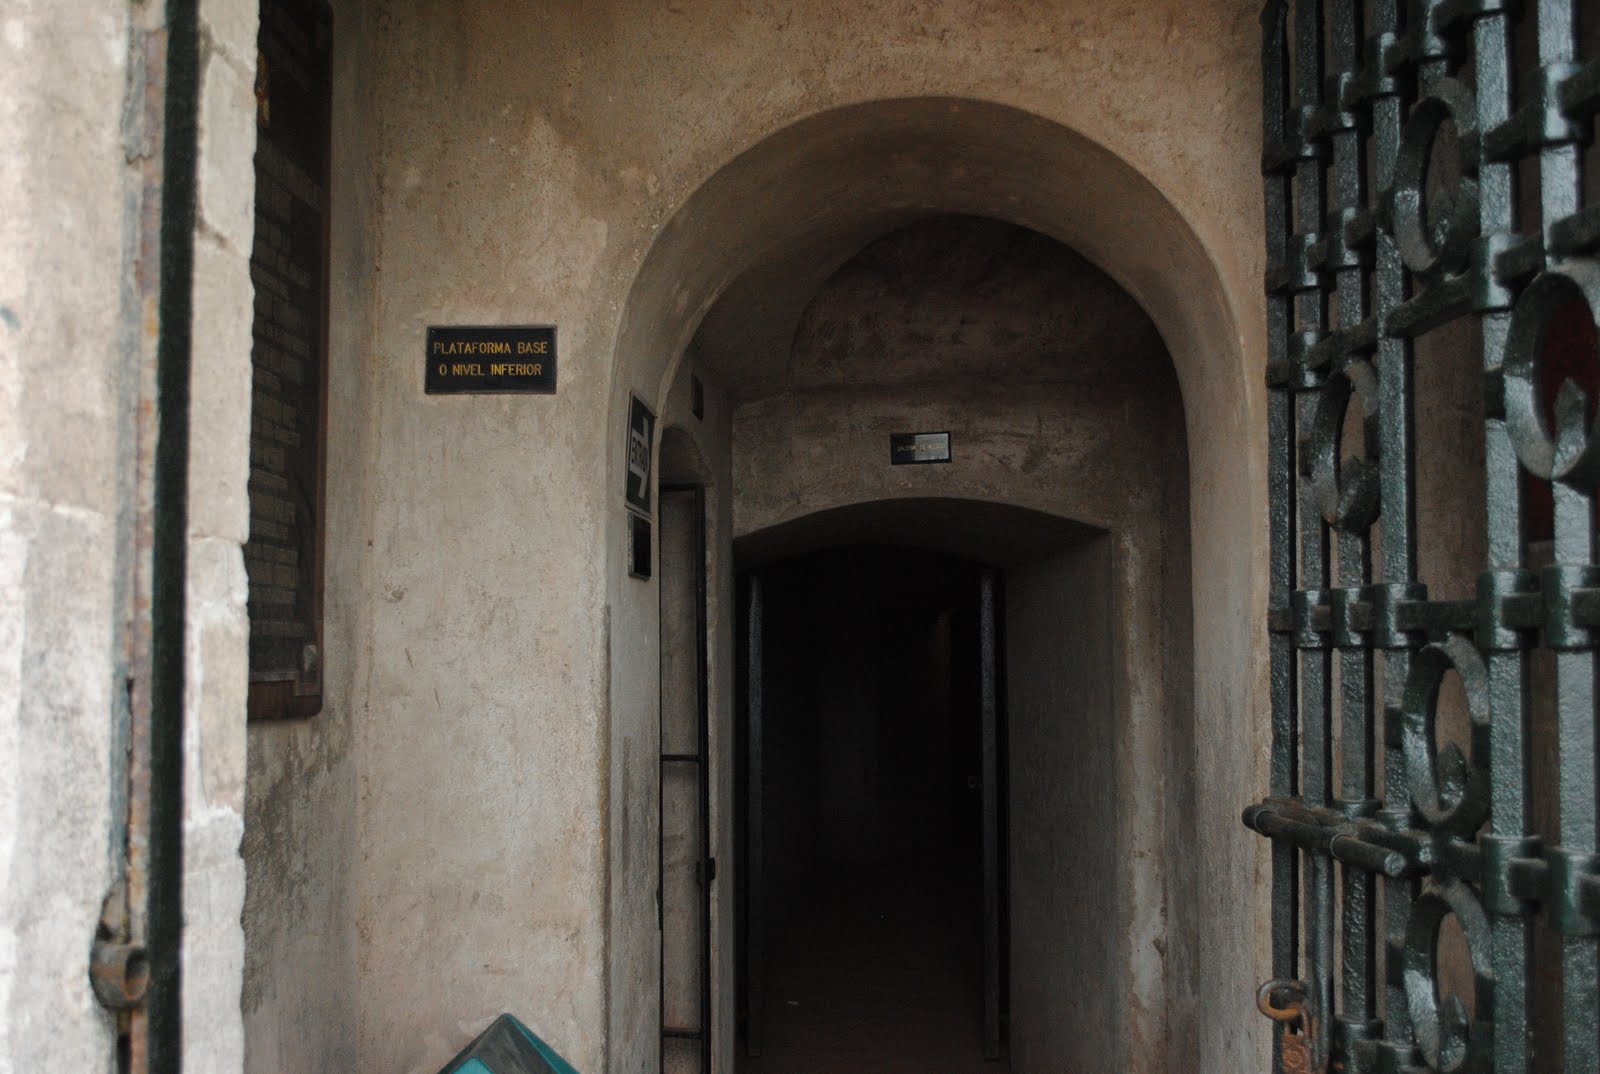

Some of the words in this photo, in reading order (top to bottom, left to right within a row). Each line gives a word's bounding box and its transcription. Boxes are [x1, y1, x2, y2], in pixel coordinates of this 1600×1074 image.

[433, 341, 511, 354] PLATAFORMA
[517, 341, 548, 354] BASE
[452, 363, 485, 376] NIVEL
[491, 363, 542, 376] INFERIOR
